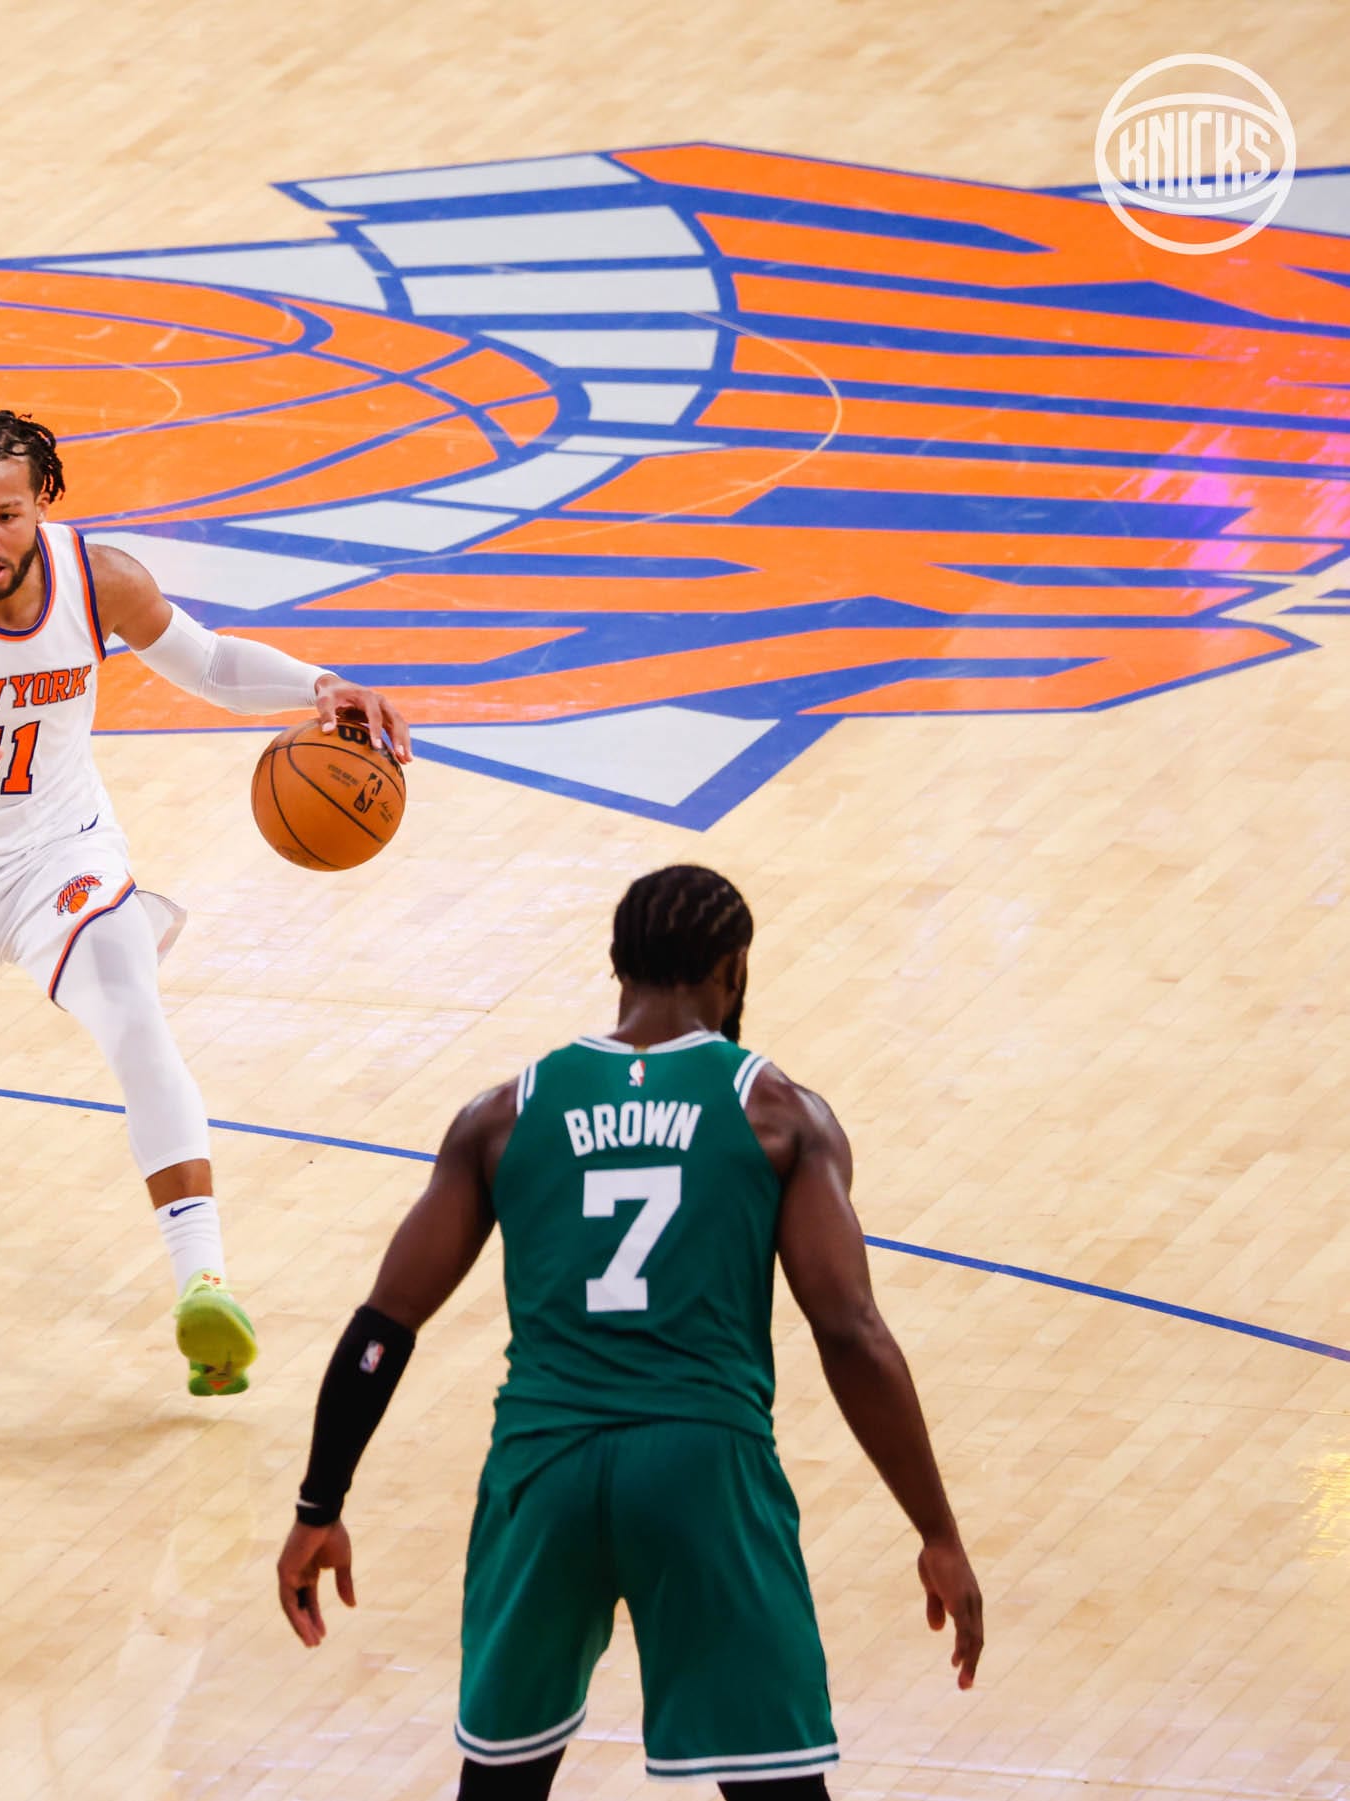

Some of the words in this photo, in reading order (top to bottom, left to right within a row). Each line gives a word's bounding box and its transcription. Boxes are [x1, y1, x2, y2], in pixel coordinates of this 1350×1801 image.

[10, 664, 92, 709] YORK
[564, 1100, 703, 1157] BROWN
[582, 1165, 683, 1312] 7
